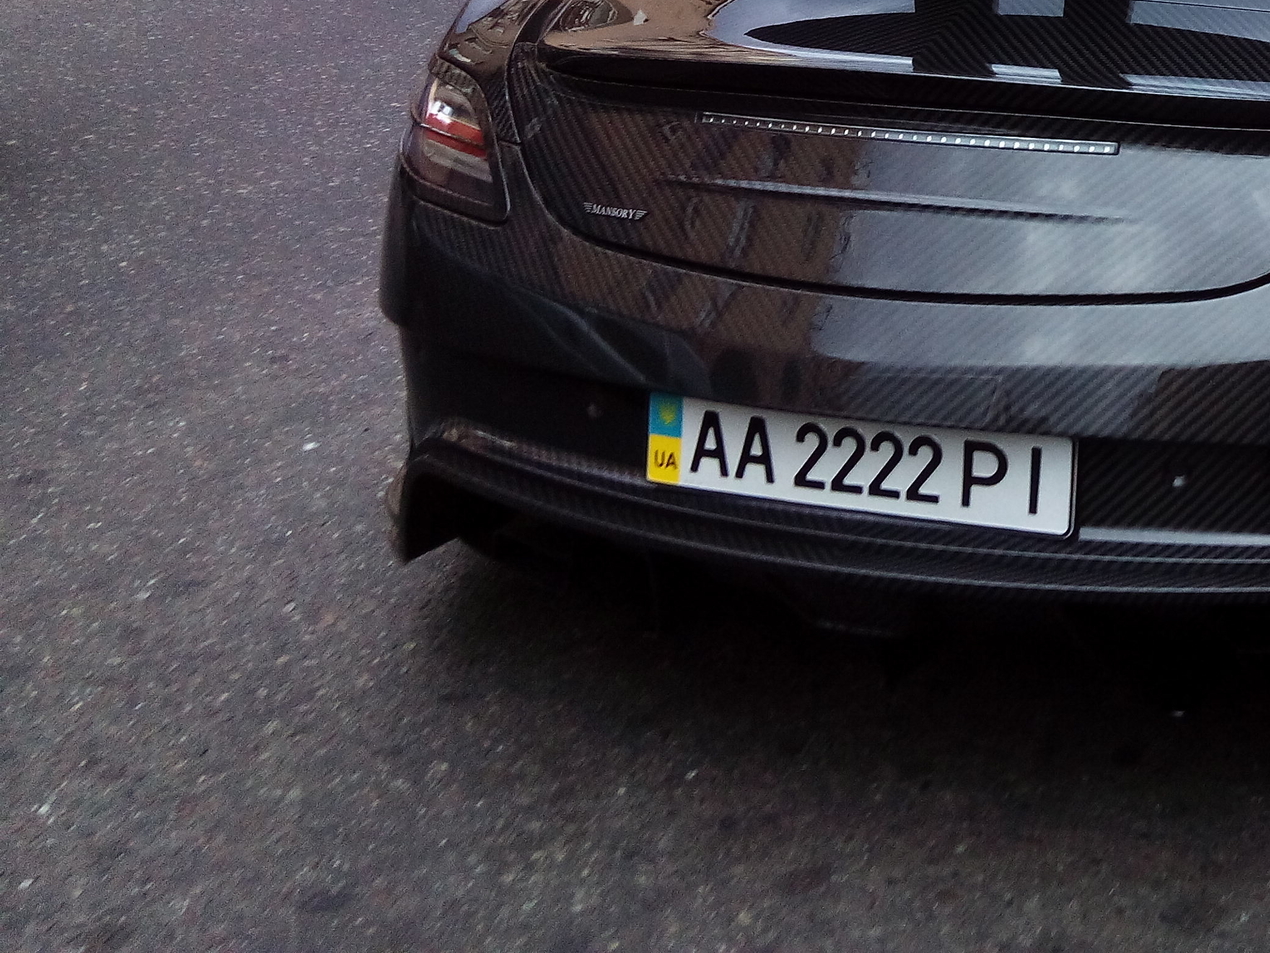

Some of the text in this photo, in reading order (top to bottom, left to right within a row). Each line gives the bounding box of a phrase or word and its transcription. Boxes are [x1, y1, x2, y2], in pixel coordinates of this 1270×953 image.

[591, 203, 636, 219] MANSORY
[653, 449, 678, 470] UA
[690, 409, 1043, 516] AA 2222 PI
